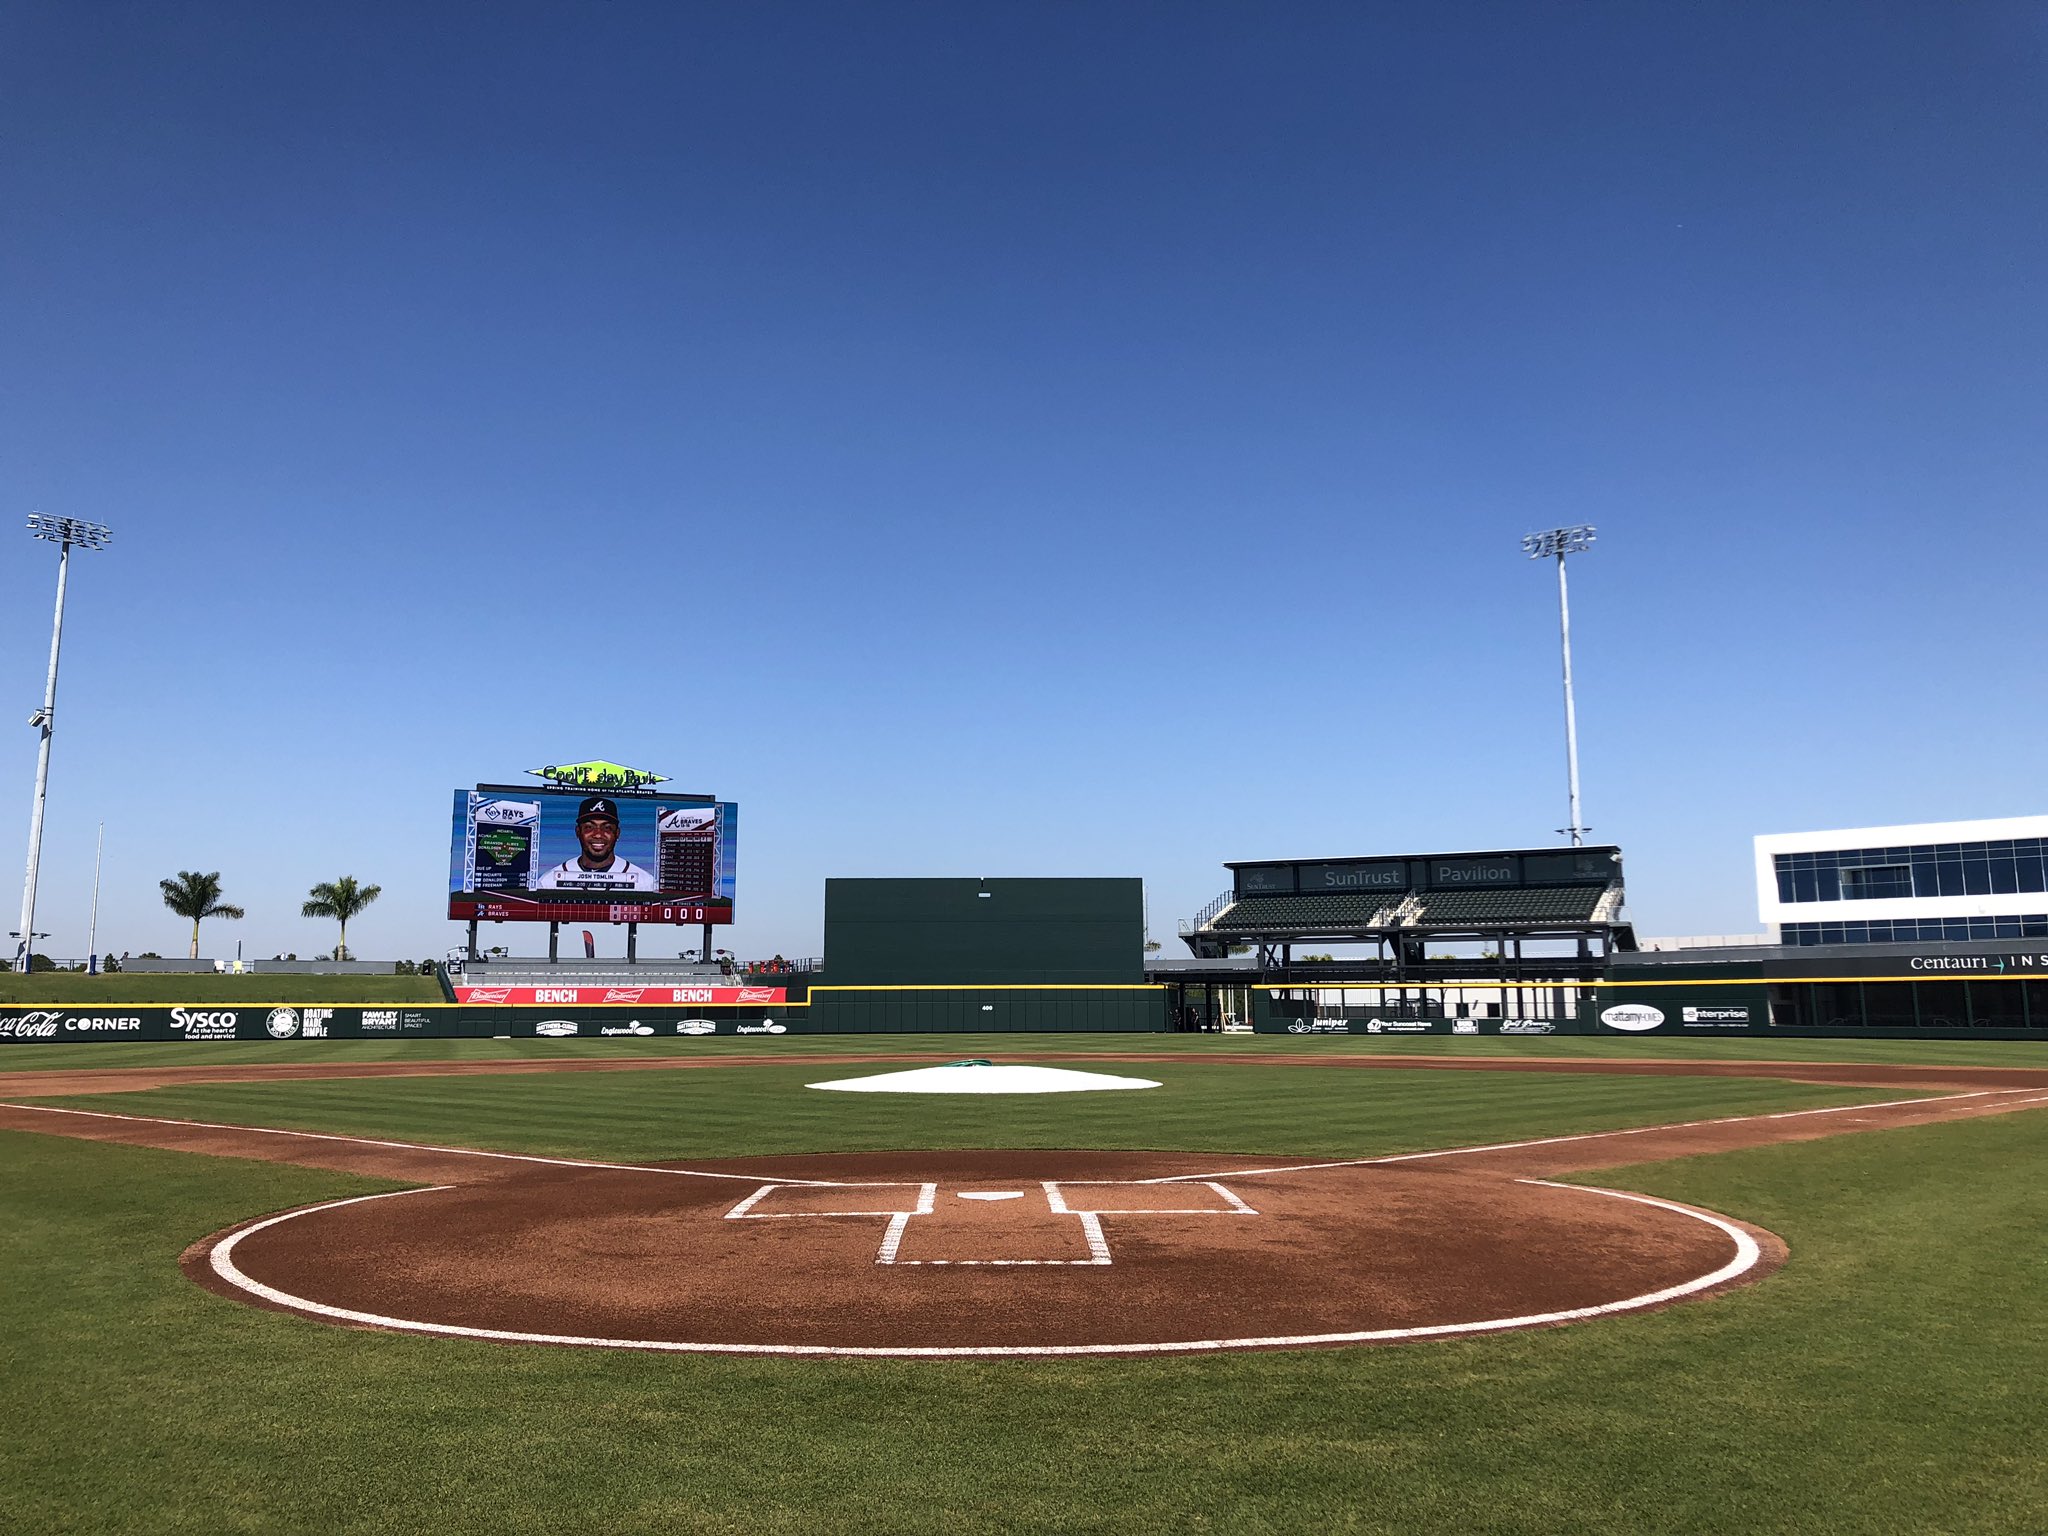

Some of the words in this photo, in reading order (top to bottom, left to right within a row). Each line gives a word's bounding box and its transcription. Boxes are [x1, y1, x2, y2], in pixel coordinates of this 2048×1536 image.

[624, 770, 656, 785] Park
[502, 809, 524, 818] RAYS
[1325, 870, 1399, 886] SunTrust
[1439, 866, 1511, 882] Pavilion
[664, 908, 671, 919] 0
[680, 908, 687, 919] 0
[696, 909, 702, 919] 0
[1910, 956, 1988, 969] Centauri
[536, 990, 577, 1003] BENCH
[673, 990, 712, 1002] BENCH
[304, 1009, 333, 1018] BOATING
[1688, 1009, 1748, 1019] enterprise
[0, 1012, 64, 1037] ca-Cola
[65, 1018, 141, 1031] CORNER
[303, 1018, 322, 1027] MADE
[1312, 1018, 1348, 1027] Juniper
[302, 1027, 328, 1037] SIMPLE
[601, 1026, 633, 1036] Englewood
[737, 1025, 767, 1034] Englewood
